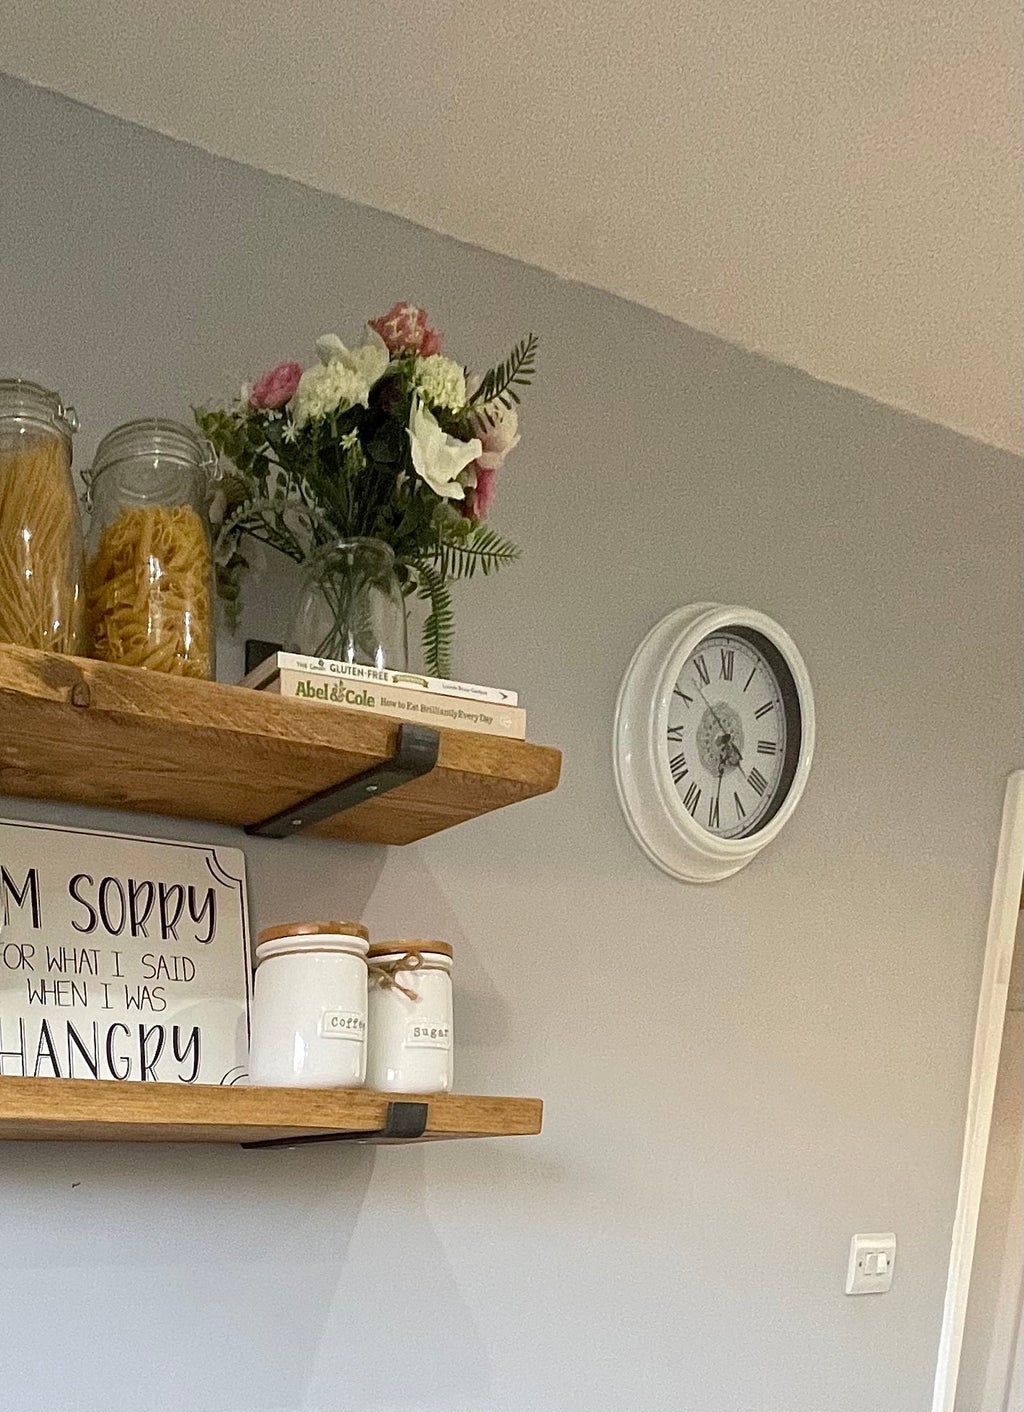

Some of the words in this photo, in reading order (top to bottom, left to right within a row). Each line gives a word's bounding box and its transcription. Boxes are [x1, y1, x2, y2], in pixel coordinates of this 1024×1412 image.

[380, 697, 397, 708] How
[406, 701, 419, 711] Eat
[420, 703, 458, 720] Brilliantly
[458, 709, 479, 723] Every
[479, 713, 494, 725] Day
[68, 873, 217, 945] SORRY
[45, 946, 102, 976] WHAT
[112, 951, 125, 978] I
[141, 954, 196, 982] SAID
[26, 978, 88, 1008] WHEN
[100, 983, 114, 1010] I
[125, 985, 168, 1012] WAS
[413, 1027, 449, 1039] Sugar
